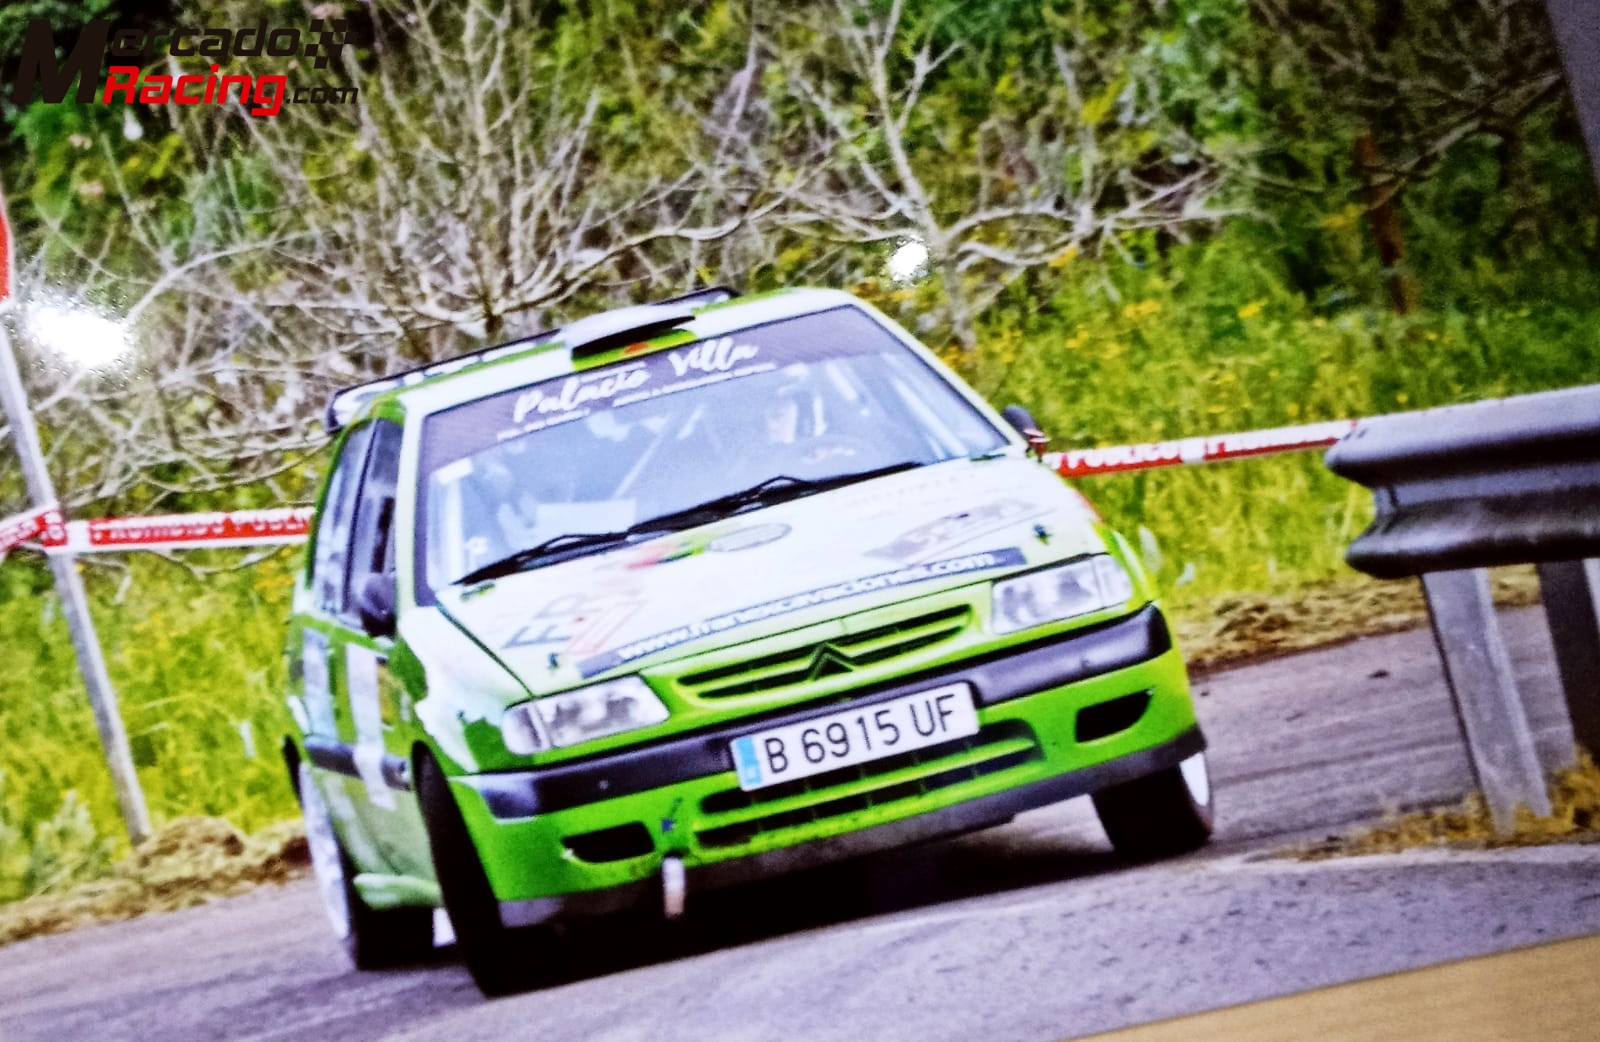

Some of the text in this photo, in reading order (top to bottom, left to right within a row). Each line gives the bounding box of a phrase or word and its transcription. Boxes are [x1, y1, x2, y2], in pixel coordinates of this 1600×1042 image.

[668, 337, 759, 377] Villa
[763, 693, 955, 774] B 6915 UF
